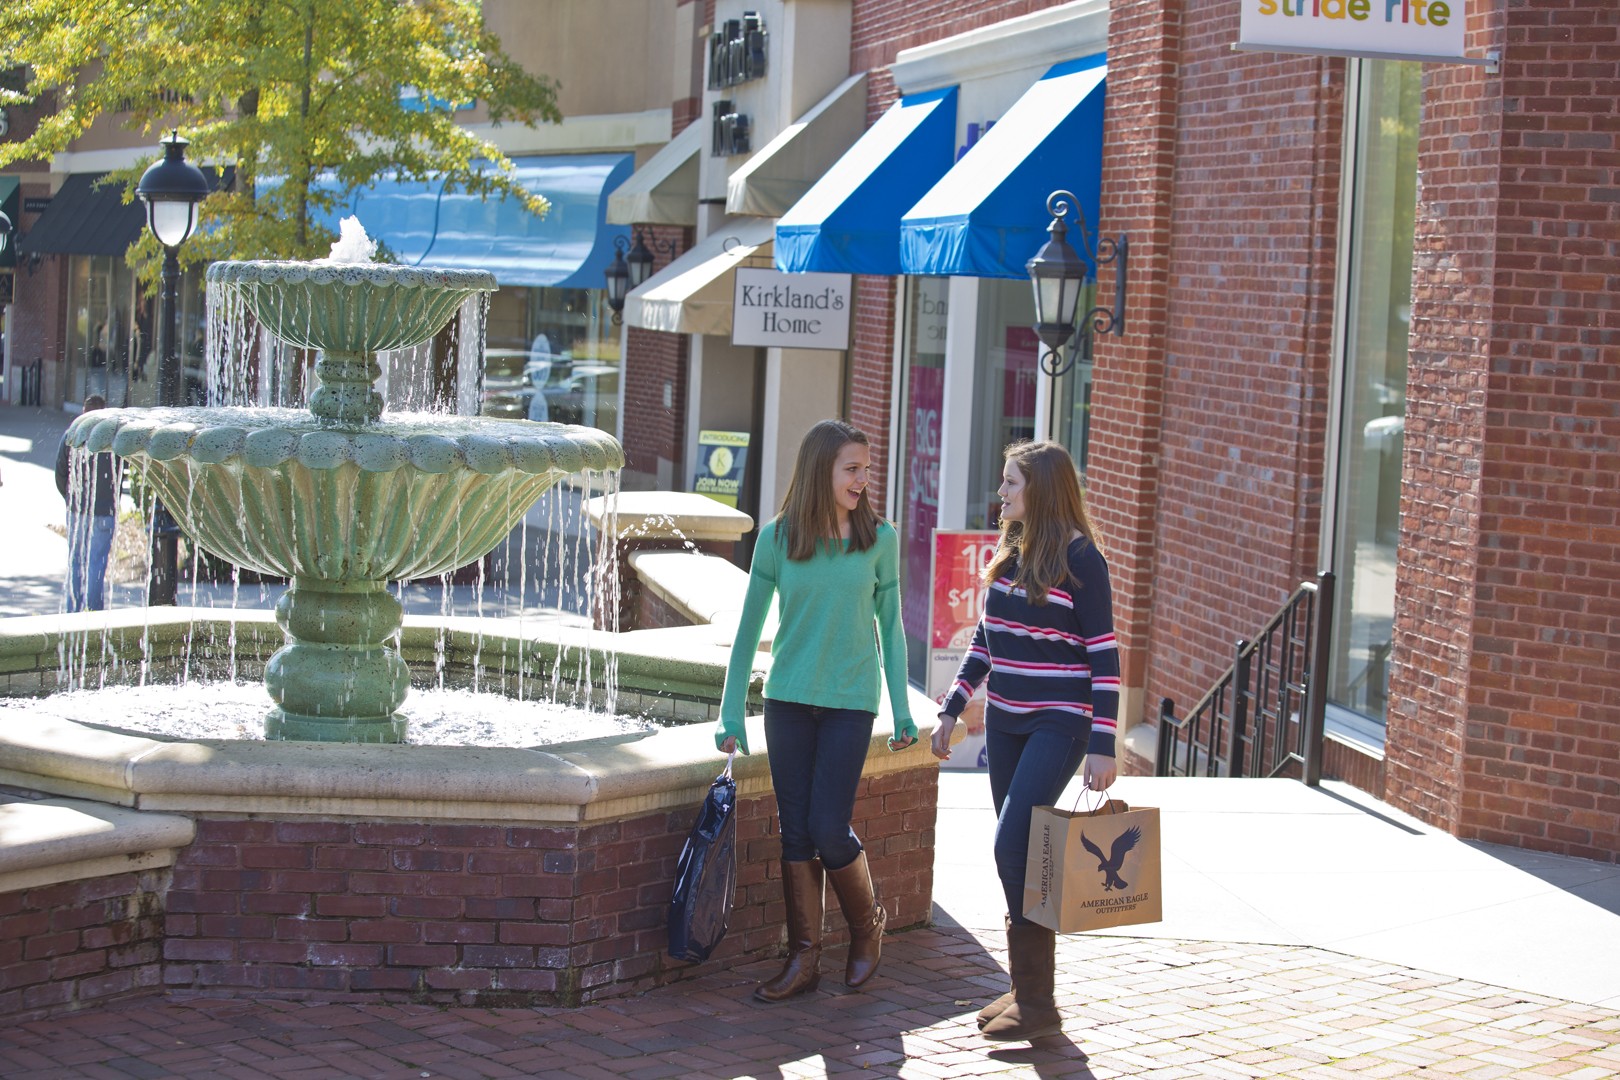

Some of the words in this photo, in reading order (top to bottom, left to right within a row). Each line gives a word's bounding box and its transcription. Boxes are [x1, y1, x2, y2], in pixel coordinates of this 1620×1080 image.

[1385, 0, 1450, 26] rite
[741, 284, 845, 311] Kirkland's
[762, 311, 822, 334] Home
[915, 407, 938, 456] BIG
[697, 477, 717, 487] JOIN
[717, 478, 739, 489] NOW
[934, 653, 959, 662] claire's
[1043, 824, 1051, 855] EAGLE
[1041, 857, 1049, 908] AMERICAN
[1080, 896, 1124, 909] AMERICAN
[1125, 892, 1149, 904] EAGLE
[1095, 903, 1137, 914] OUTFITTERS
